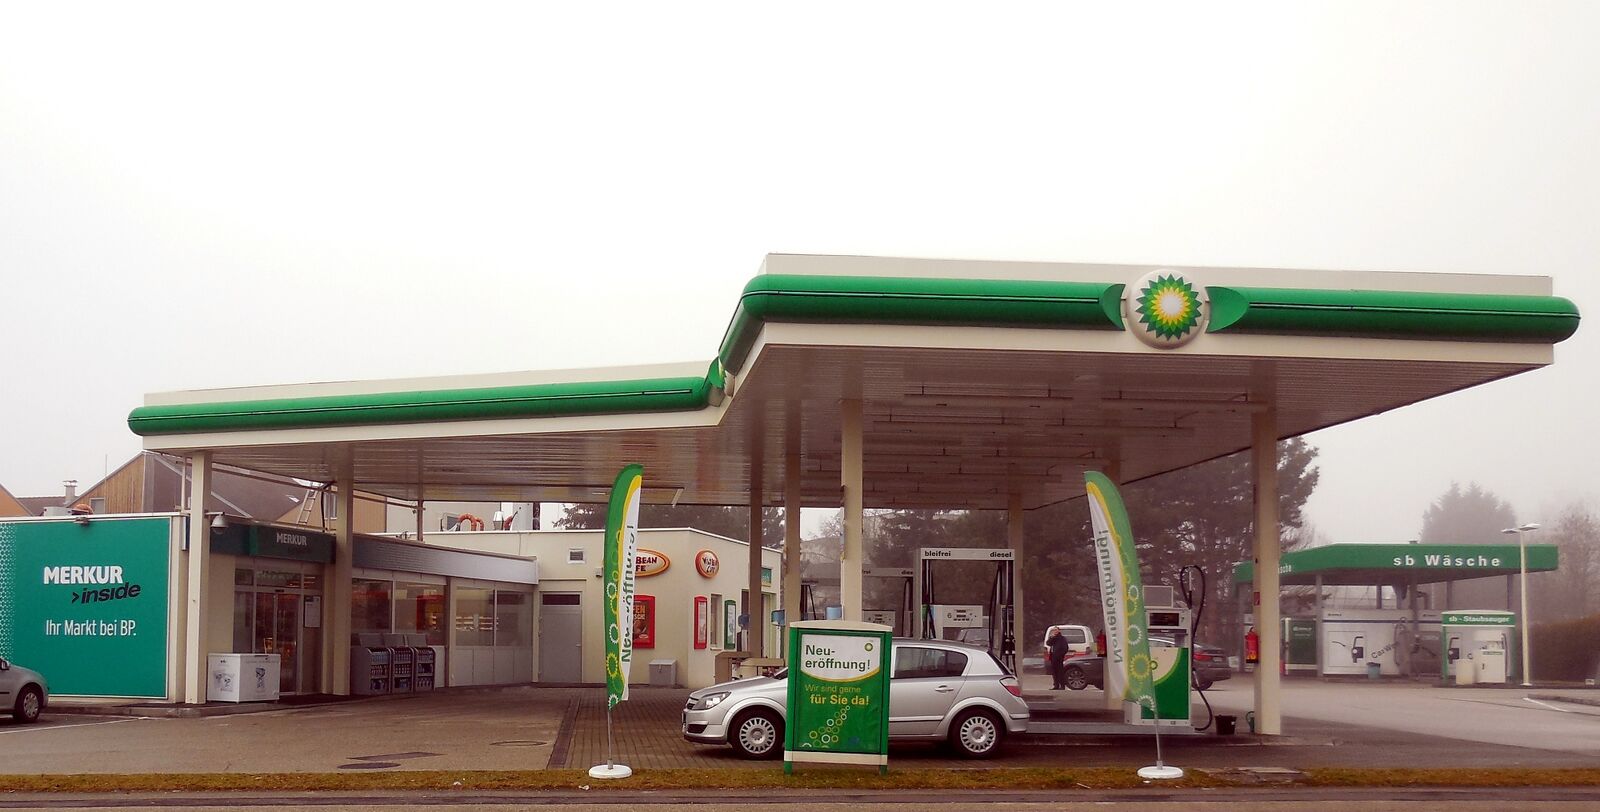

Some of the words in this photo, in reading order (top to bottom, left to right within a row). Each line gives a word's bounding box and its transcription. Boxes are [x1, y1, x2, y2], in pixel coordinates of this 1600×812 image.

[276, 532, 307, 546] MERKUR
[635, 556, 658, 565] BEAN
[1393, 555, 1415, 566] sb
[1425, 554, 1502, 567] Wäsche
[43, 565, 123, 585] MERKUR
[1463, 615, 1510, 624] Staubsauger
[45, 620, 61, 636] Ihr
[64, 619, 96, 636] Markt
[100, 619, 117, 636] bei
[120, 620, 137, 636] BP.
[805, 644, 836, 656] Neu-
[805, 658, 871, 672] eröffnung!
[805, 684, 819, 692] Wir
[821, 685, 837, 693] sind
[810, 694, 826, 705] für
[830, 694, 848, 705] Sie
[851, 695, 870, 706] da!
